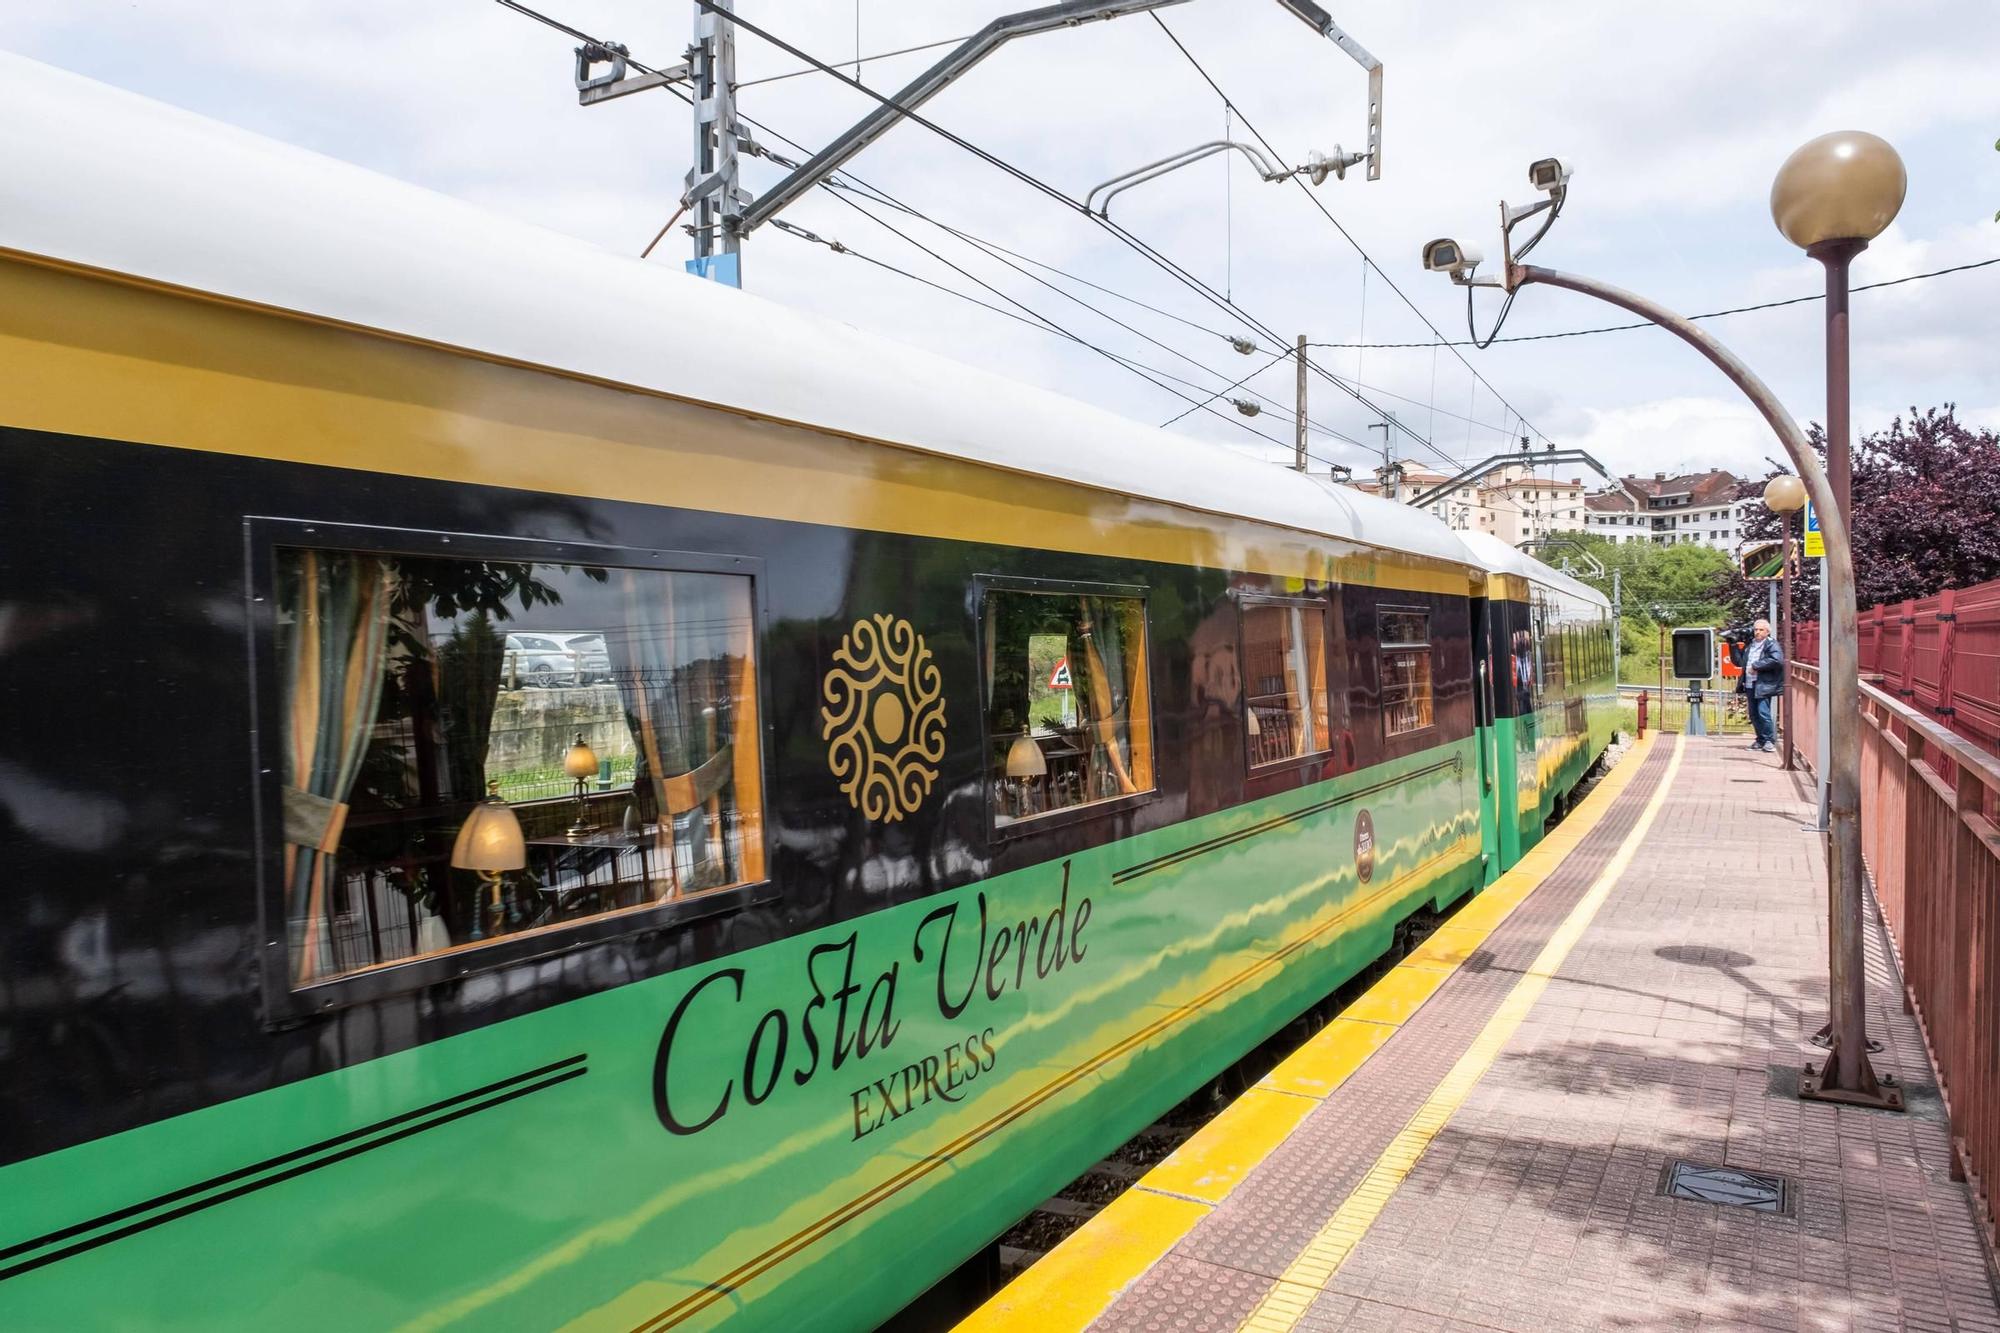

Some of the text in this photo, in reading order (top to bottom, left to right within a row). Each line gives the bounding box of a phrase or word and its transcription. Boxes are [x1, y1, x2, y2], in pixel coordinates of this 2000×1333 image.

[652, 859, 1092, 1136] Costa Verde
[850, 1027, 996, 1143] EXPRESS
